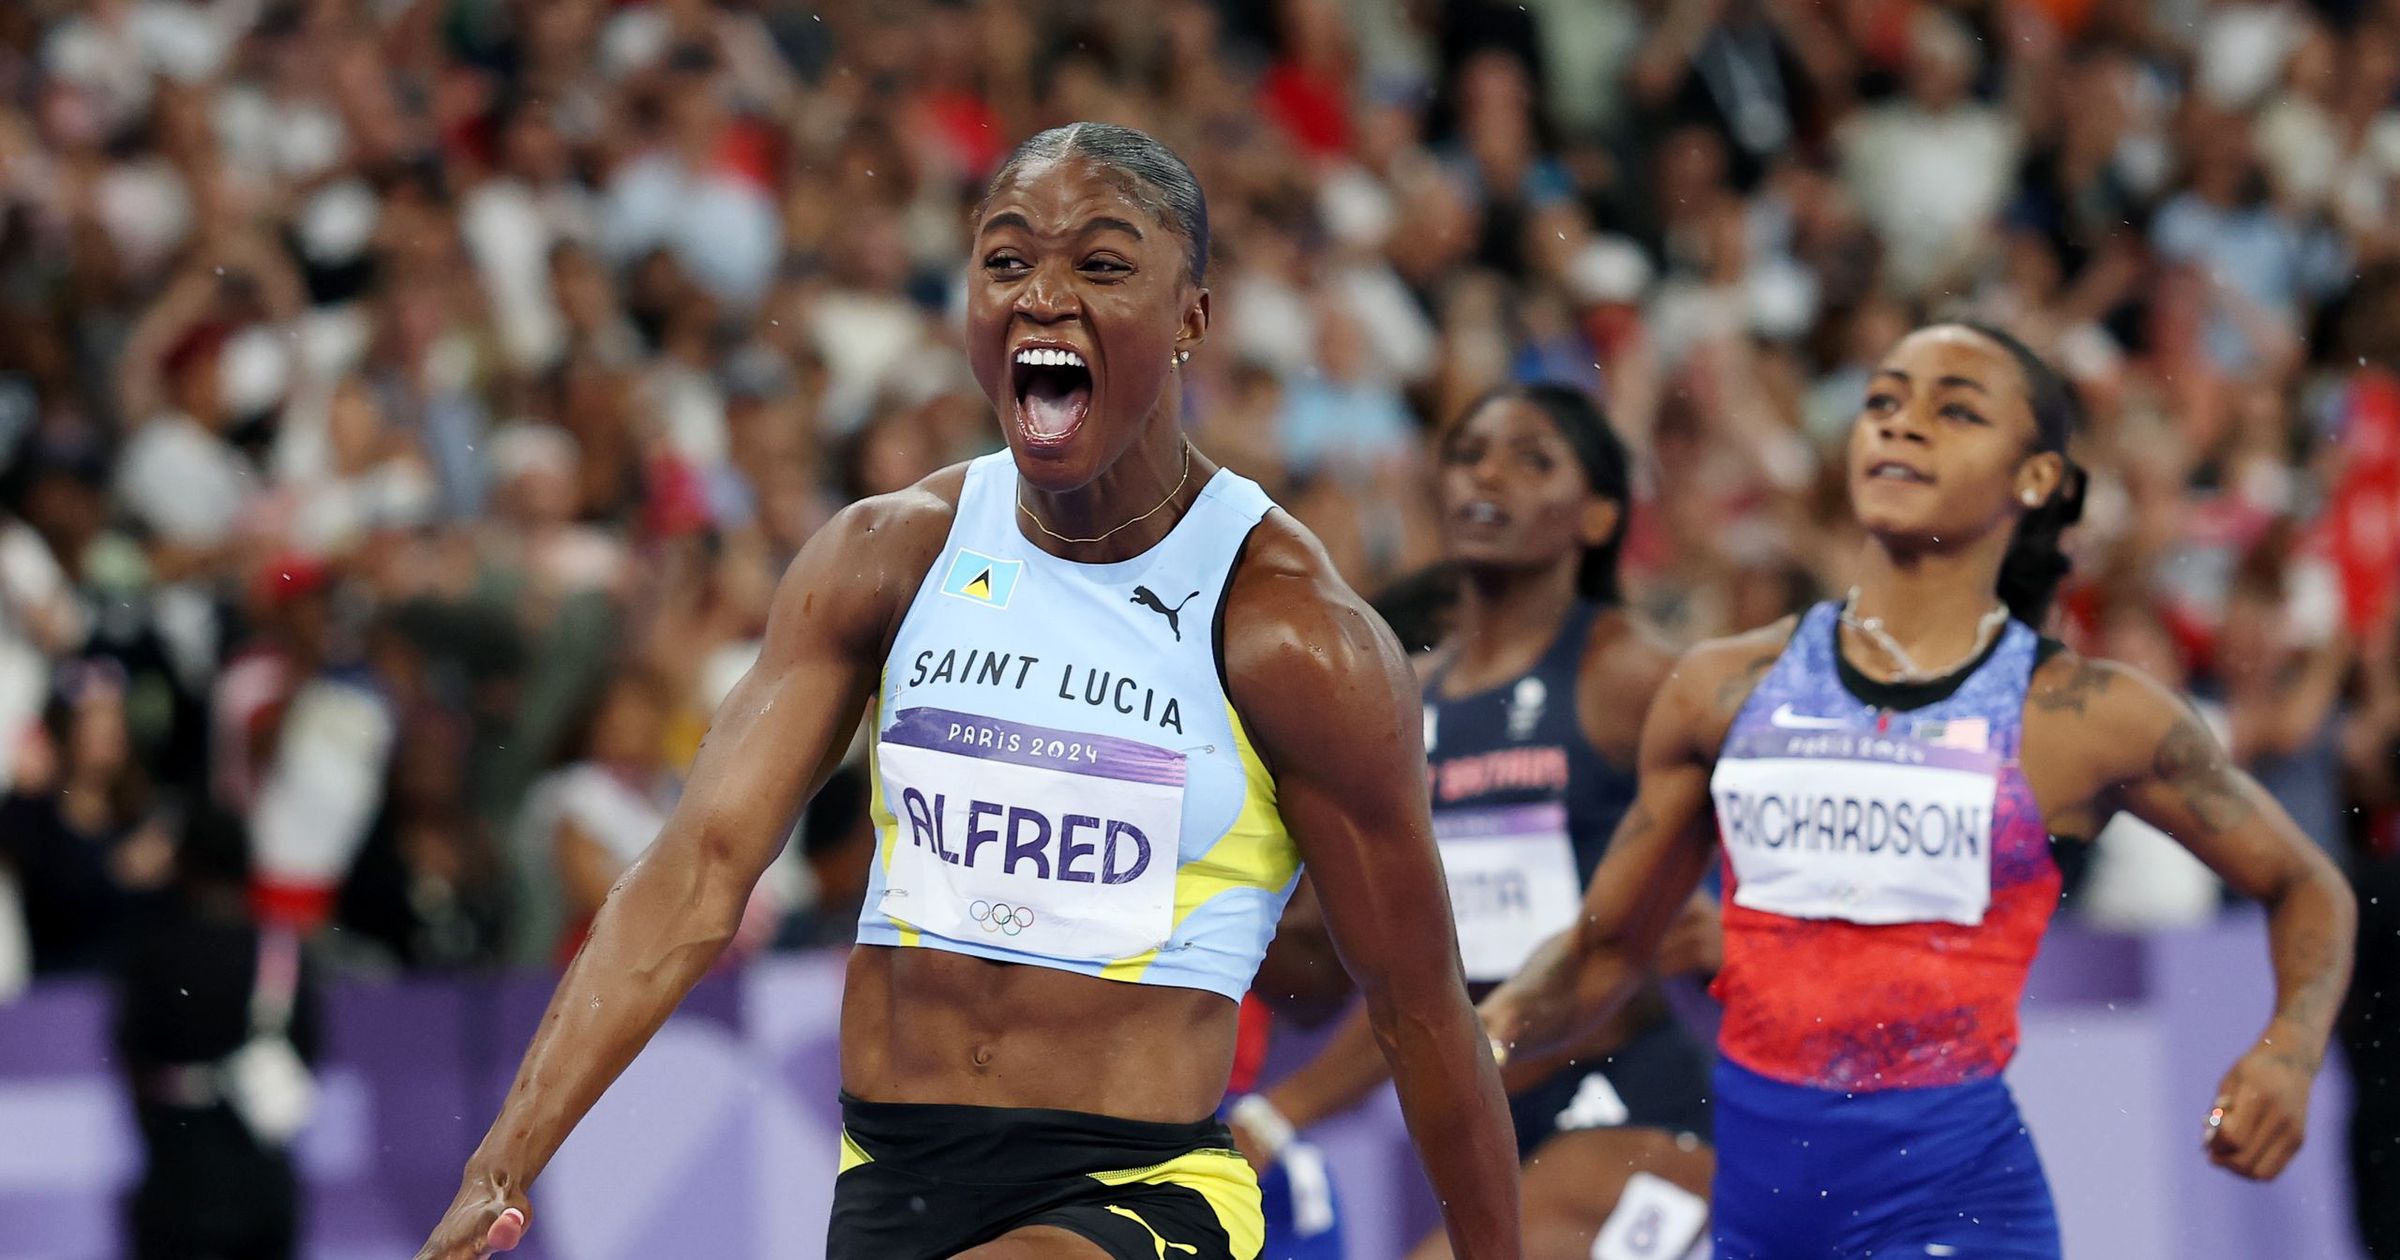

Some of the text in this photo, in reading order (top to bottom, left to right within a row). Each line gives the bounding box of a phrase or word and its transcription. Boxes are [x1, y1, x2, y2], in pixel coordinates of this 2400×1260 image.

[909, 649, 1184, 735] SAINT LUCIA
[947, 722, 1099, 764] PARIS 2024
[902, 787, 1152, 885] ALFRED
[1725, 790, 1980, 857] RICHARDSON
